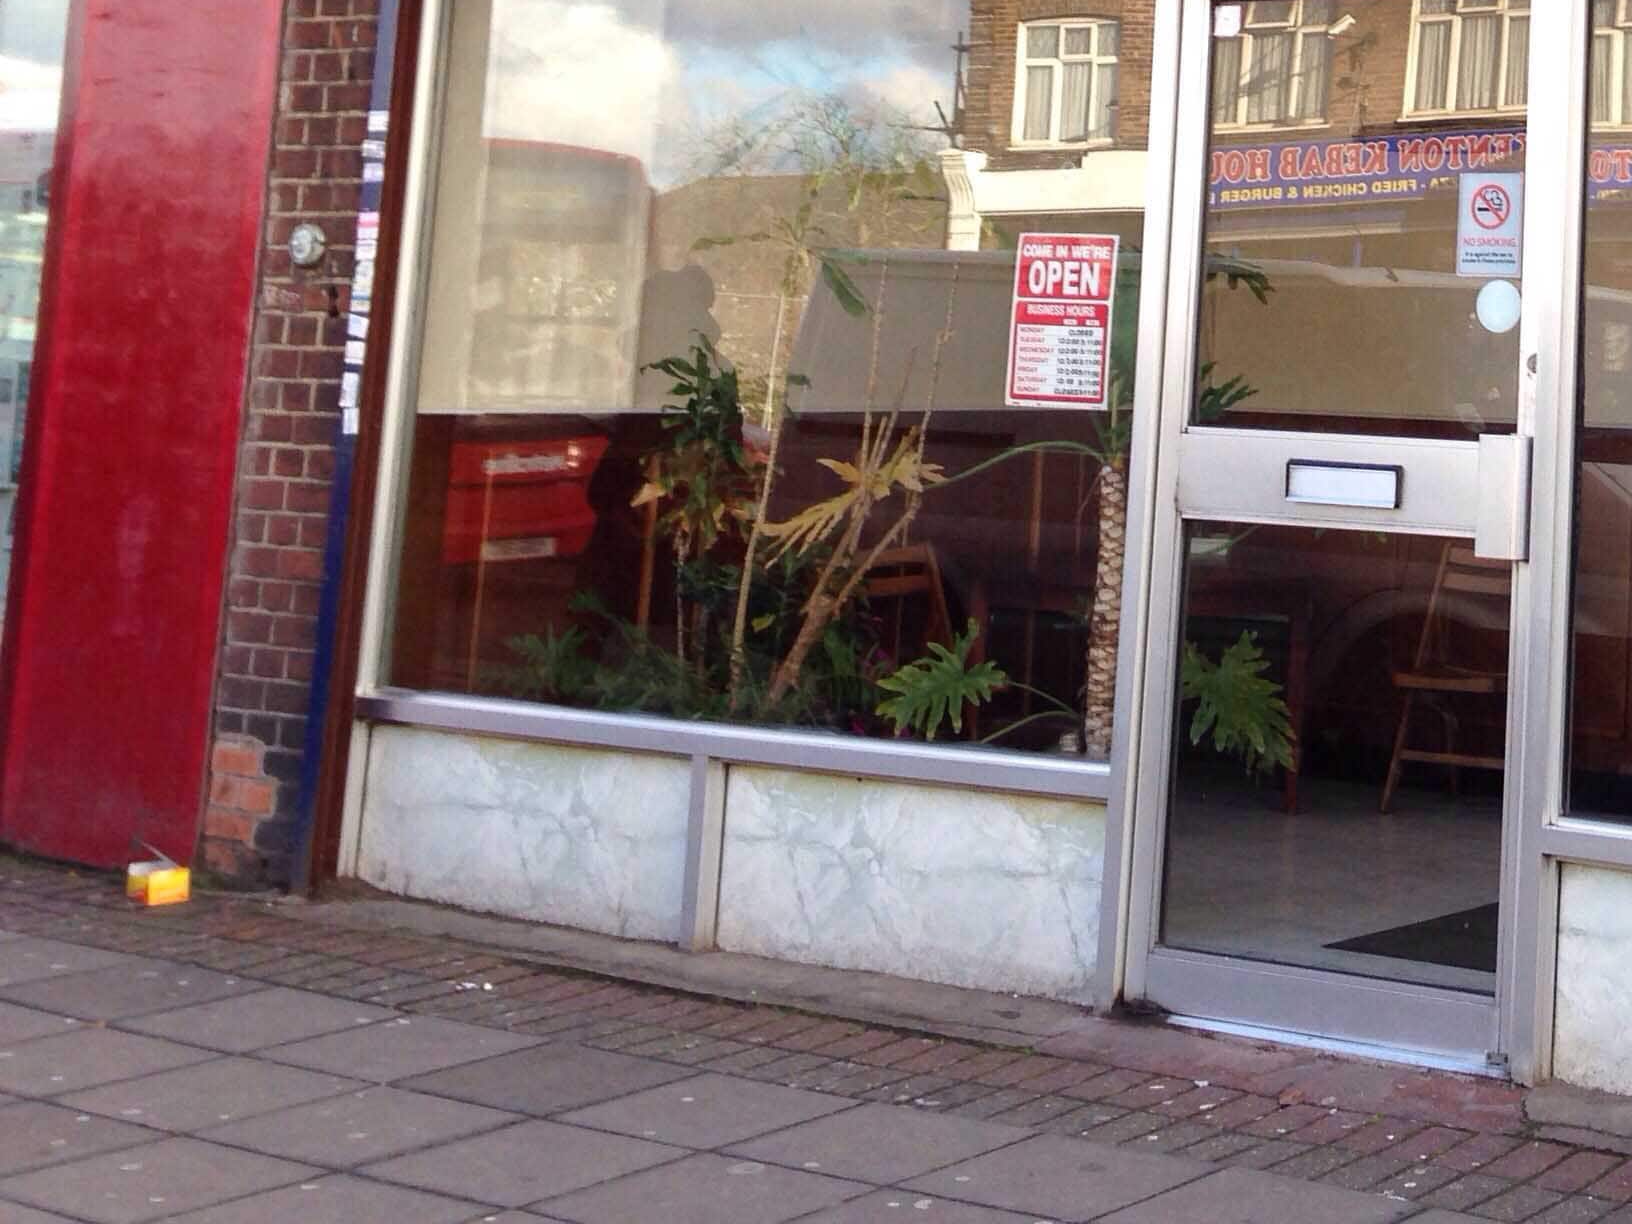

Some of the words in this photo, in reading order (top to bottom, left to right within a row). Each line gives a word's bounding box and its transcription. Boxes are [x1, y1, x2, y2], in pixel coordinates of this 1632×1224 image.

[1022, 243, 1054, 258] COME
[1055, 244, 1069, 258] IN
[1028, 260, 1101, 297] OPEN
